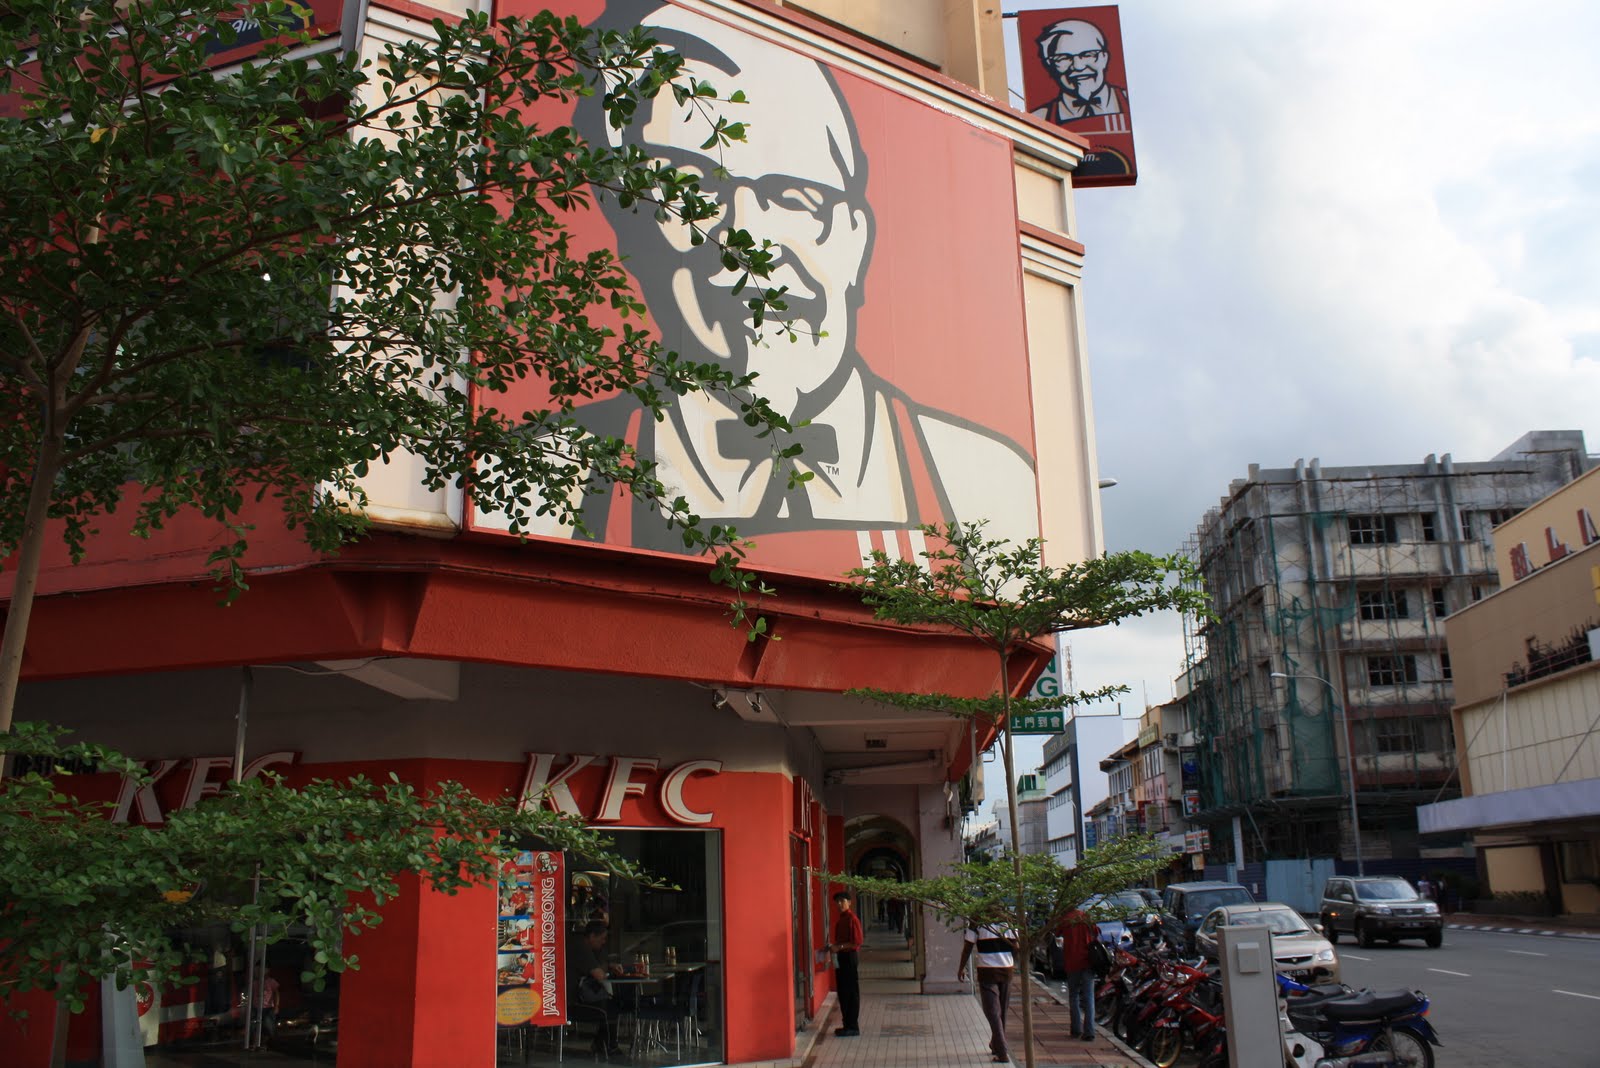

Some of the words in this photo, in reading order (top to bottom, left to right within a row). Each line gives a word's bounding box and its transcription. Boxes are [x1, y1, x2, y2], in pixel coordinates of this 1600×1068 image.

[825, 465, 840, 476] TM
[516, 751, 724, 826] KFC
[540, 877, 555, 944] KOSONG
[542, 945, 560, 1017] JAWATAN
